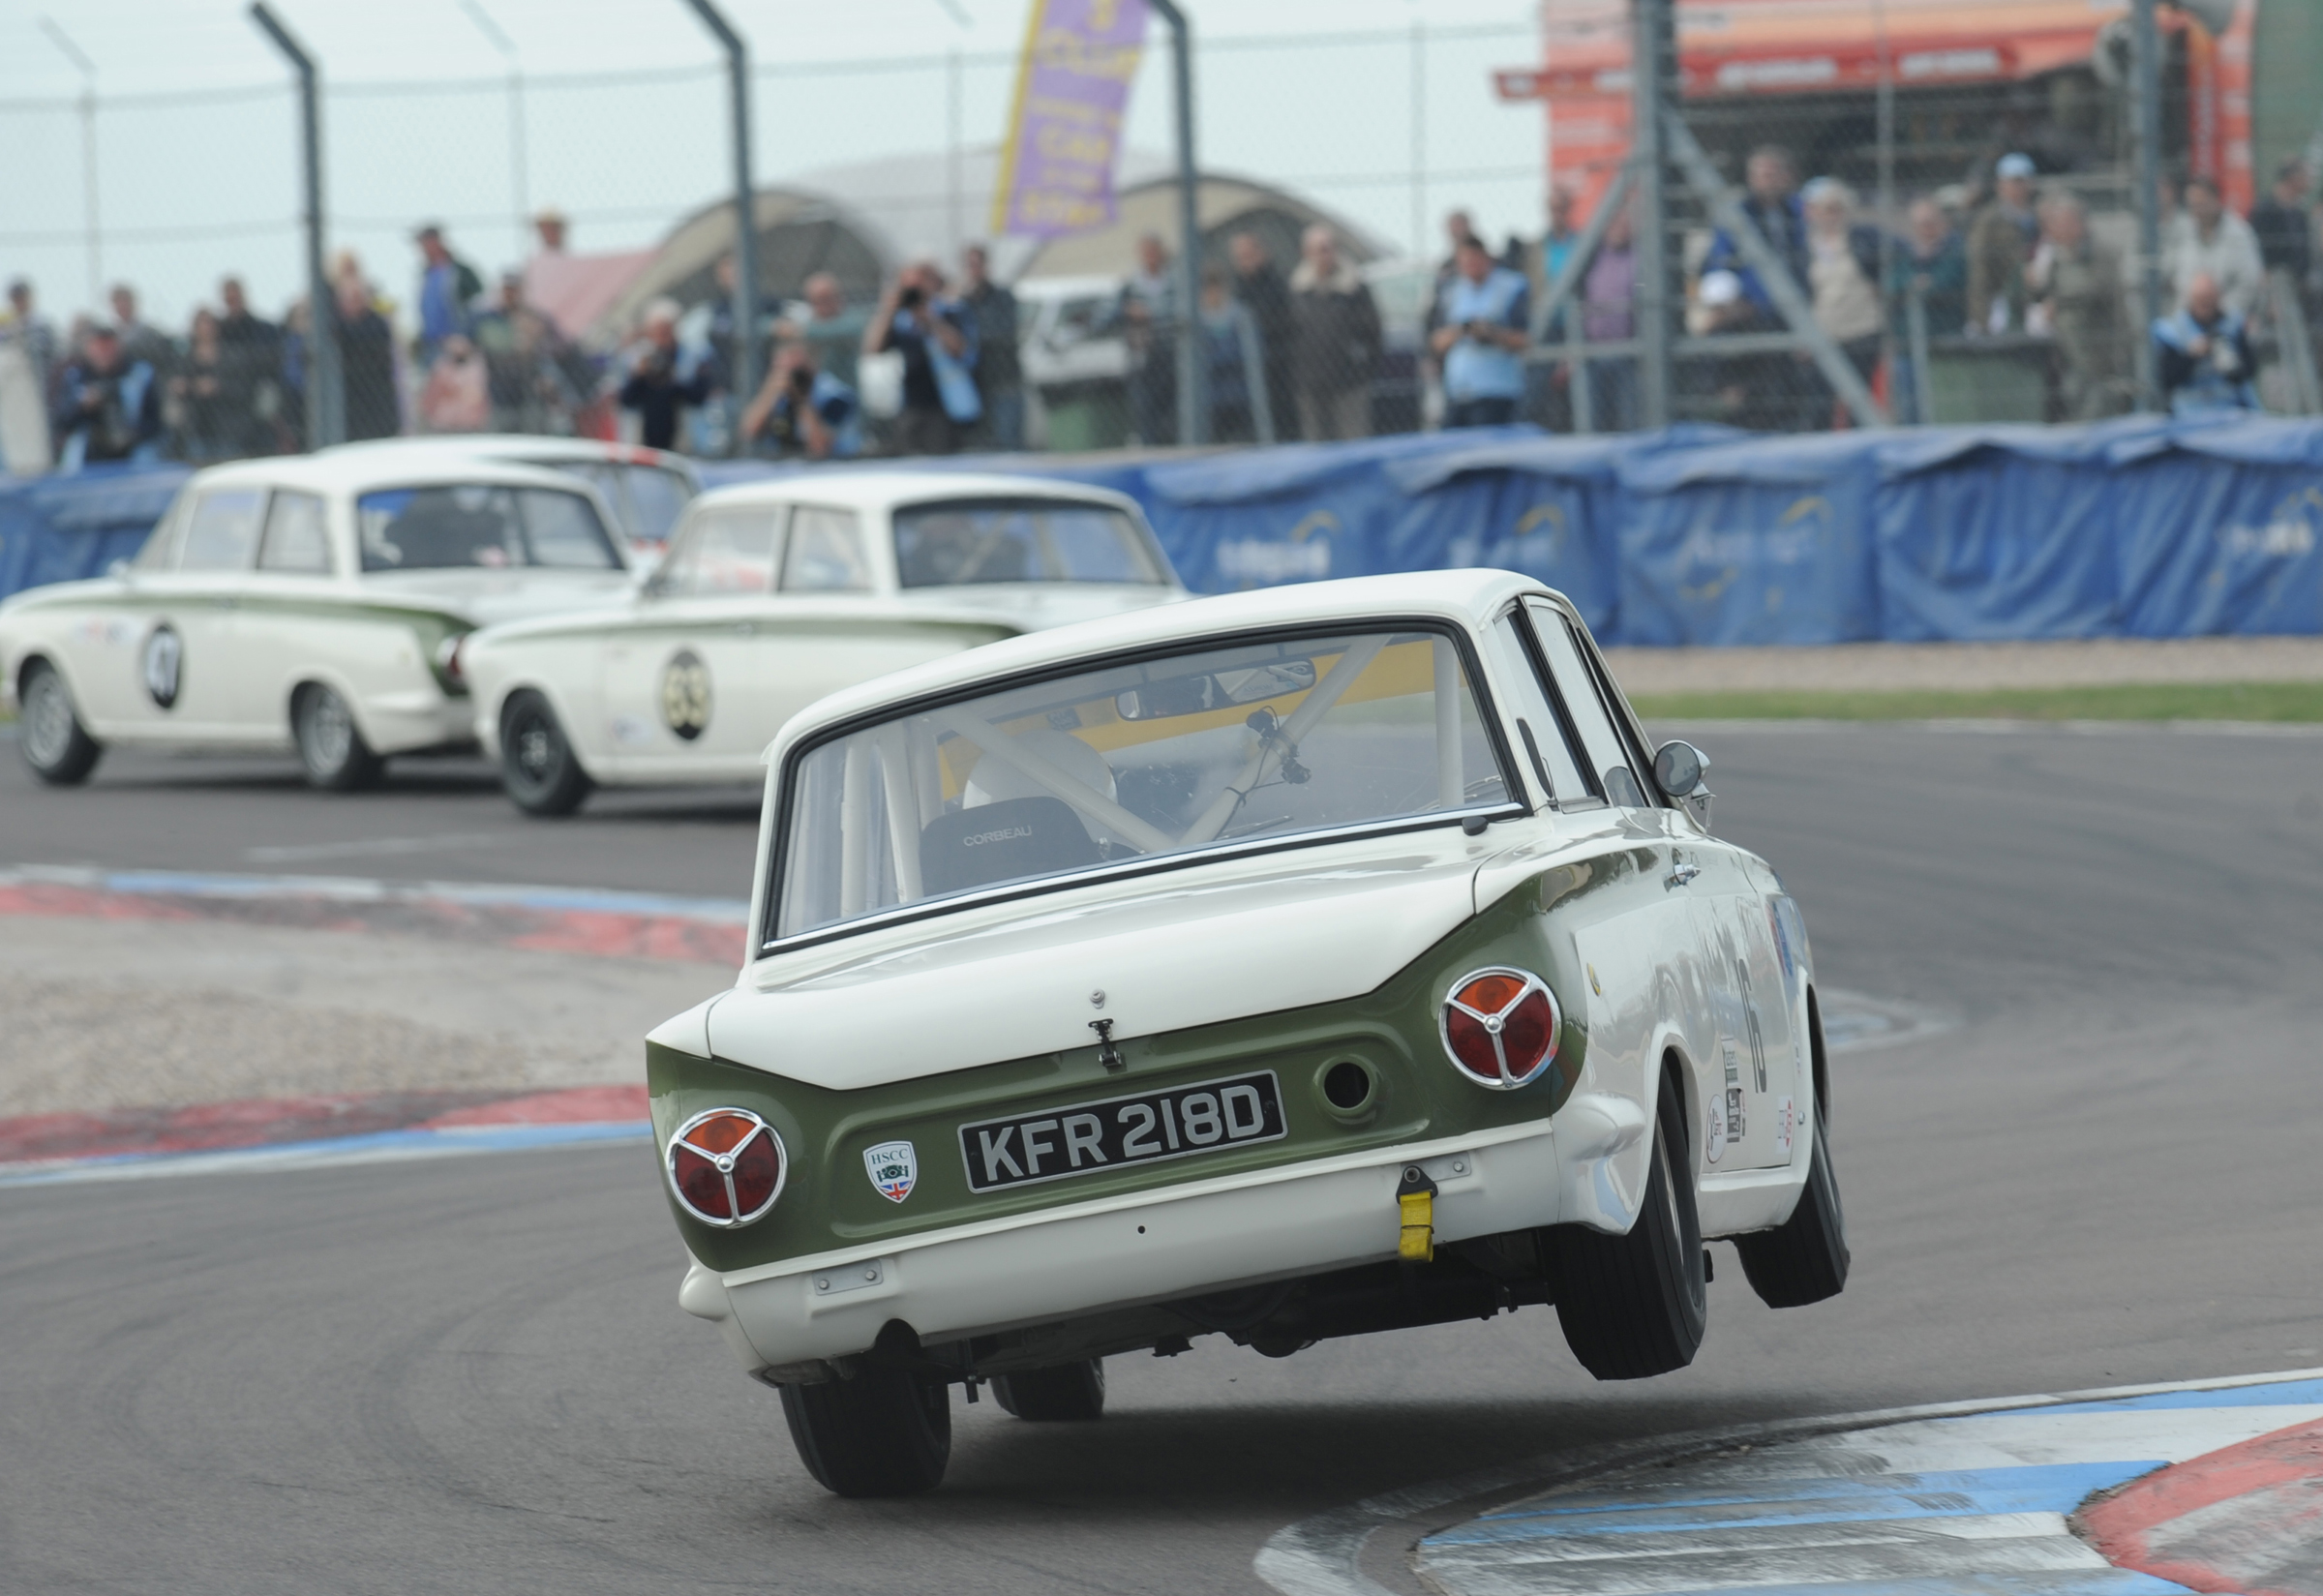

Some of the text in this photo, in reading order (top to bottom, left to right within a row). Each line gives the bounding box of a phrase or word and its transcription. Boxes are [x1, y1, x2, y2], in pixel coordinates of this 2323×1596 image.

[963, 825, 1033, 847] CORBEAU
[979, 1084, 1265, 1182] KFR 218D
[871, 1148, 909, 1165] HSCC
